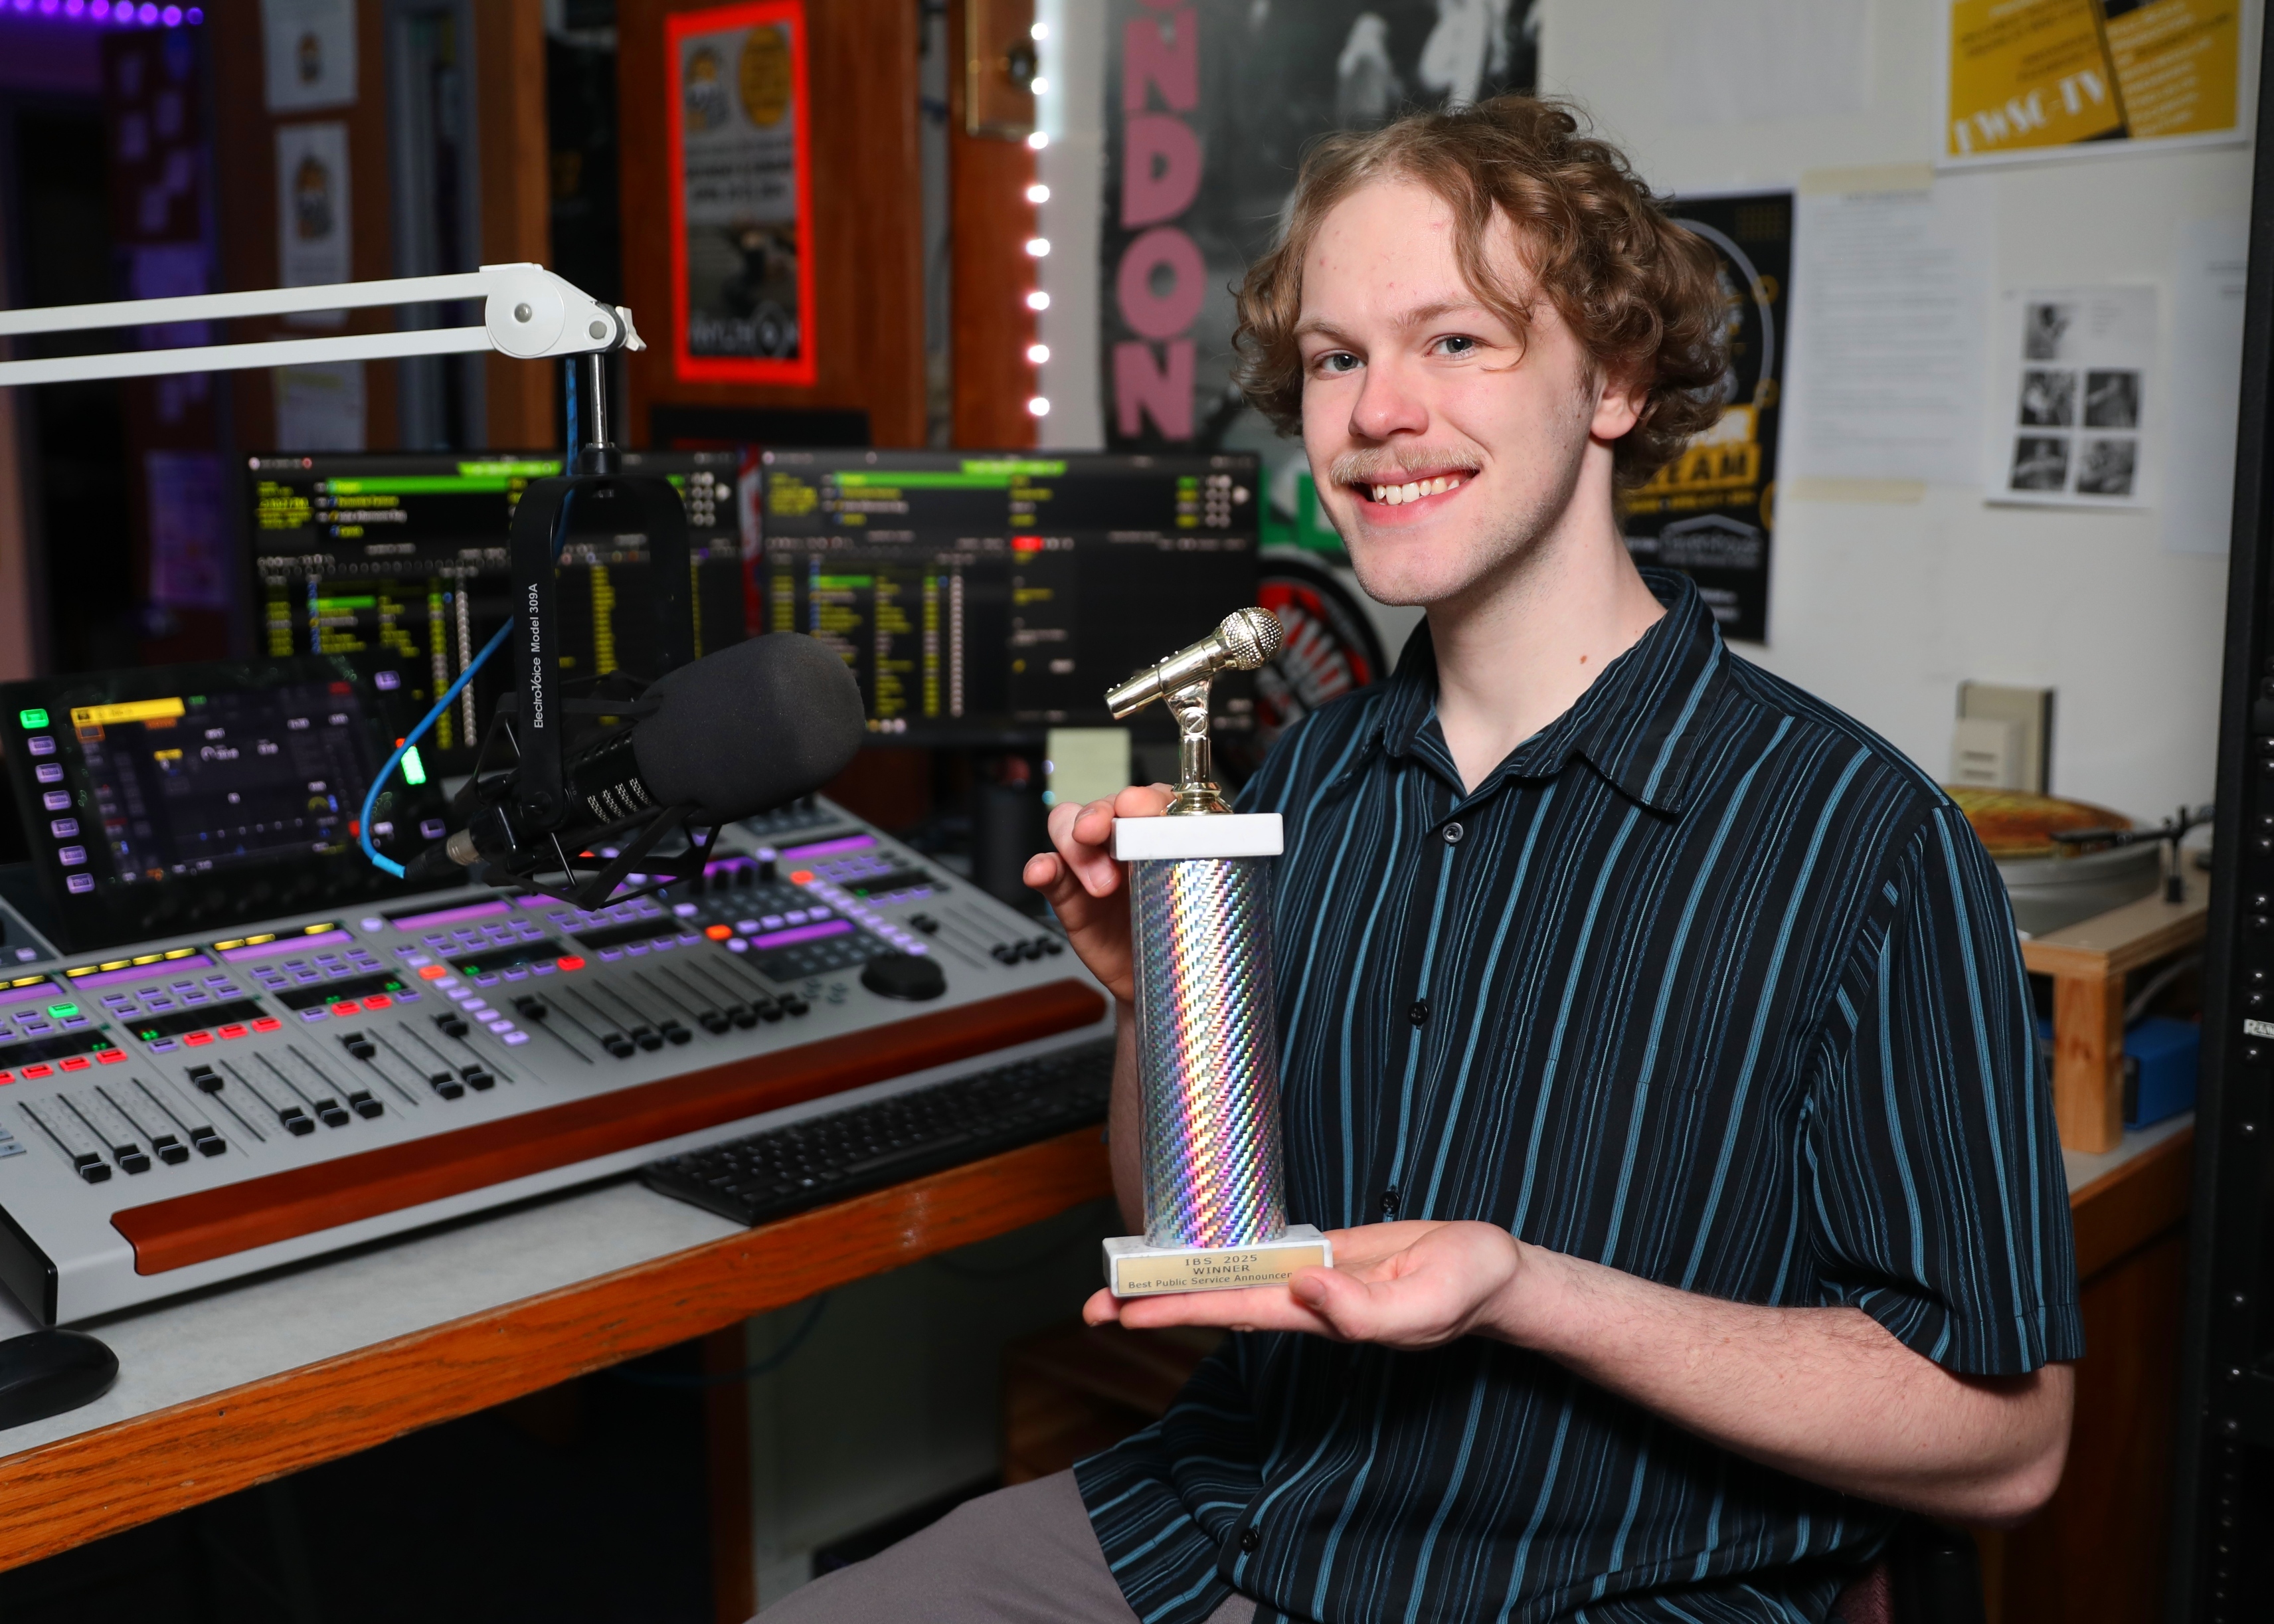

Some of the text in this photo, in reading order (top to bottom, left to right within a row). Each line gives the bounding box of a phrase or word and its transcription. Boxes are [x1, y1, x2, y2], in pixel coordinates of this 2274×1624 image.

[1112, 0, 1207, 442] NDON
[528, 583, 539, 613] 309A
[530, 616, 541, 652] Model
[1185, 1254, 1258, 1266] IBS 2025
[1193, 1264, 1250, 1275] WINNER
[1128, 1280, 1152, 1289] Best
[1156, 1278, 1187, 1287] Public
[1191, 1275, 1231, 1285] Service
